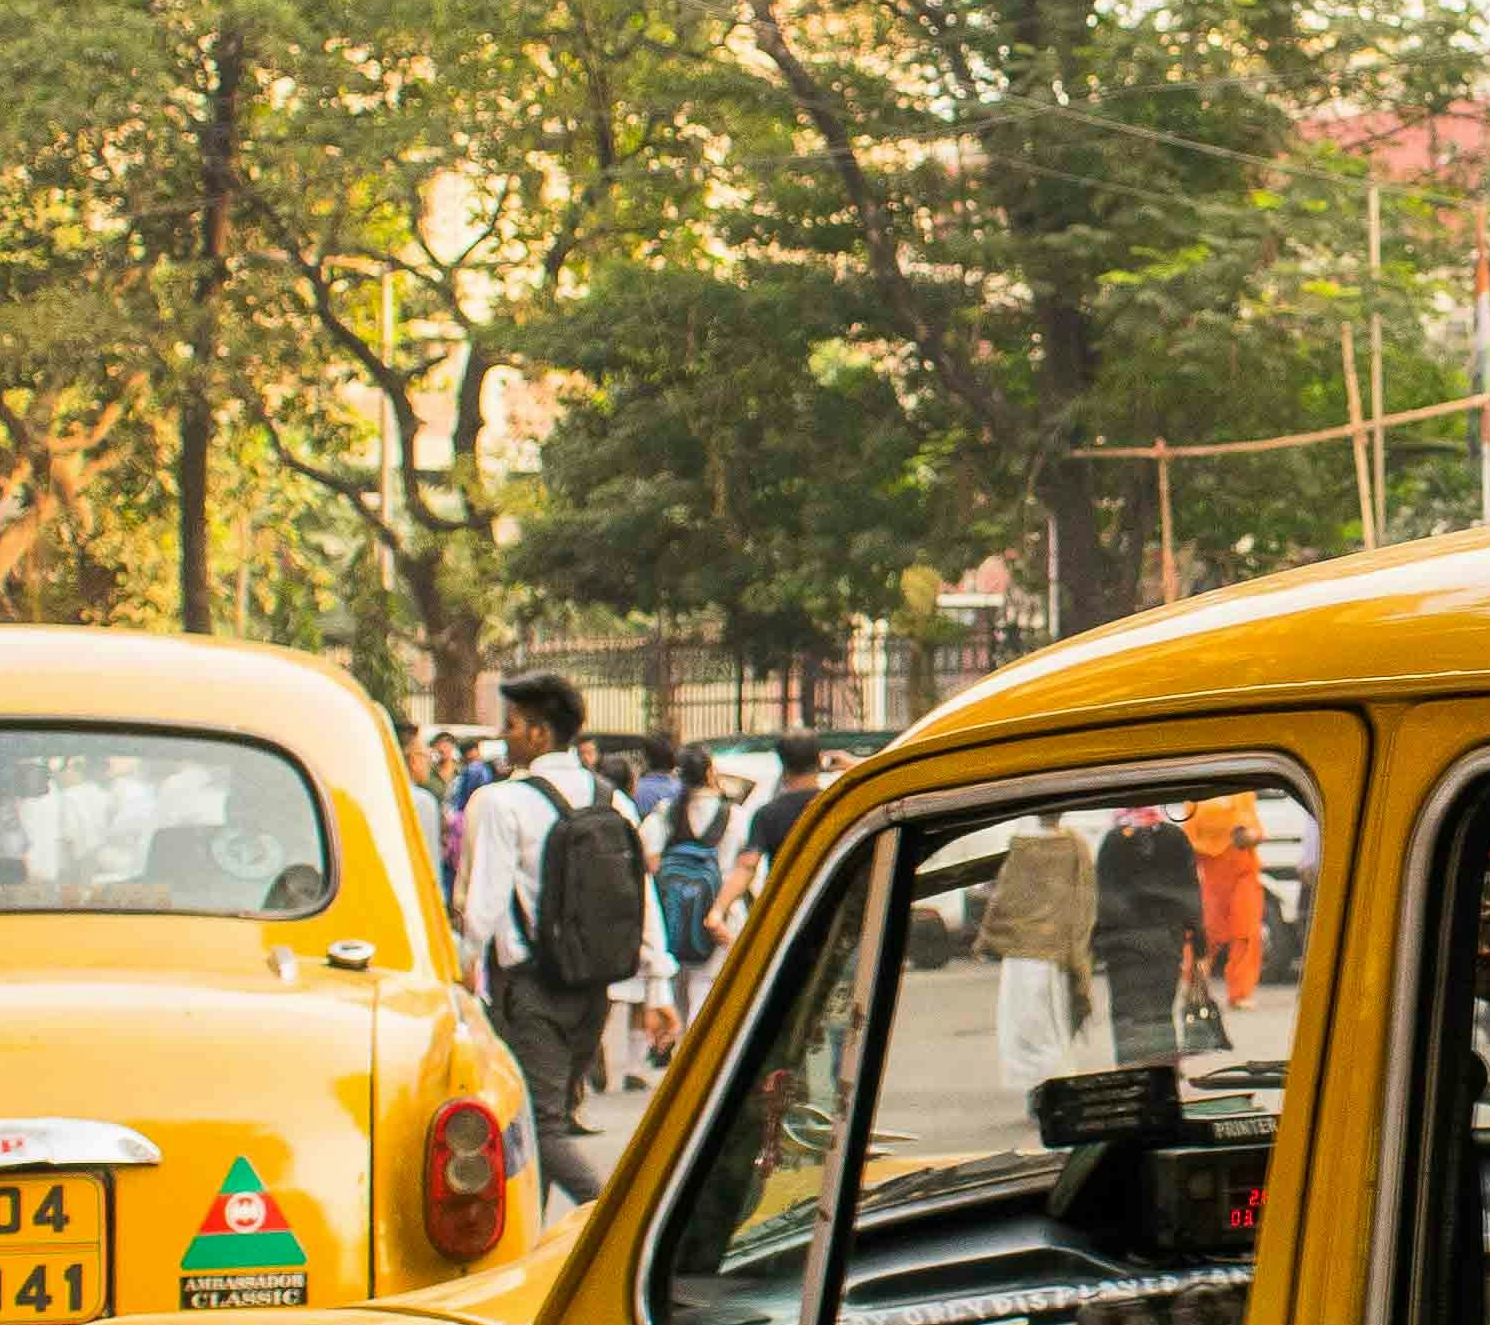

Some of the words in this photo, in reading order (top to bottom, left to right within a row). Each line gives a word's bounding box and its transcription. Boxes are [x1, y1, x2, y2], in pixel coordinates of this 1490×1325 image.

[1212, 1116, 1278, 1140] PRINTER
[184, 1273, 304, 1292] AMBASSADOR
[190, 1289, 301, 1309] CLASSIC
[996, 1275, 1178, 1313] DISPLAYED
